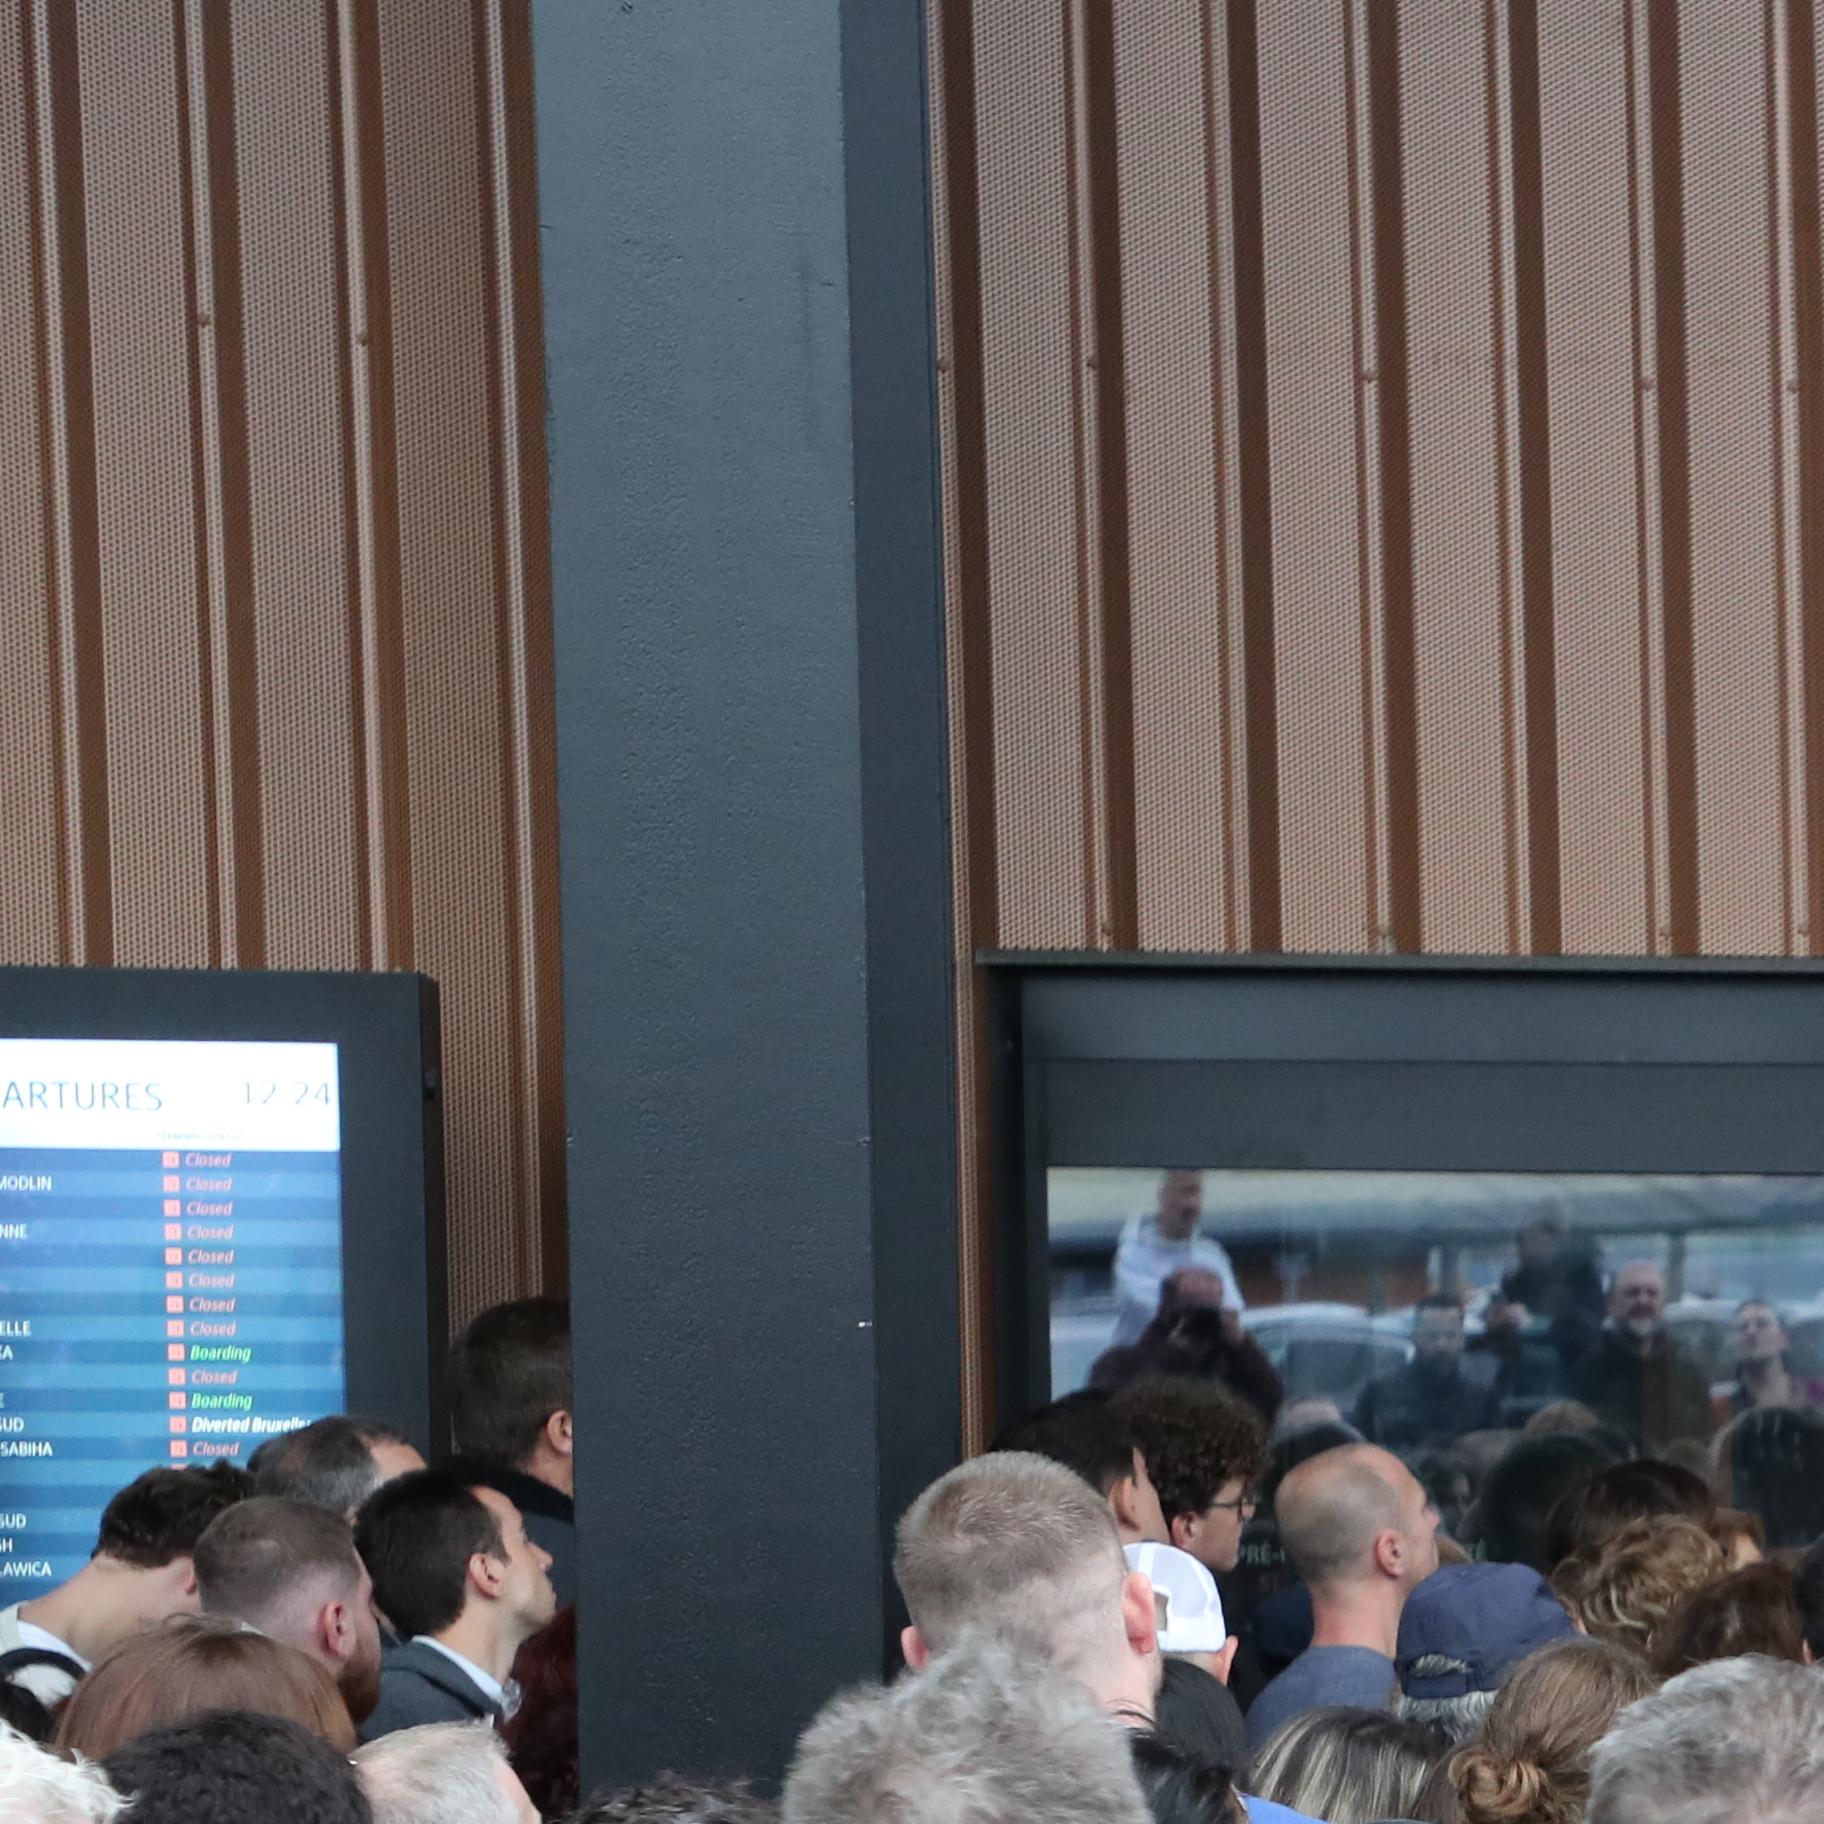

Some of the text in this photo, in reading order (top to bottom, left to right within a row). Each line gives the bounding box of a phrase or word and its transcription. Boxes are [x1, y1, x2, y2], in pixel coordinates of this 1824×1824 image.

[243, 1080, 331, 1106] 12:24
[185, 1152, 232, 1168] Closed
[186, 1177, 233, 1192] Closed
[186, 1201, 234, 1216] Closed
[187, 1225, 235, 1240] Closed
[188, 1249, 235, 1264] Closed
[188, 1273, 236, 1288] Closed
[189, 1297, 237, 1313] Closed
[190, 1321, 237, 1336] Closed
[190, 1344, 252, 1364] Boarding
[191, 1369, 239, 1385] Closed
[191, 1392, 253, 1412] Boarding
[191, 1416, 251, 1433] Diverted
[1, 1441, 240, 1457] SABIHA Closed
